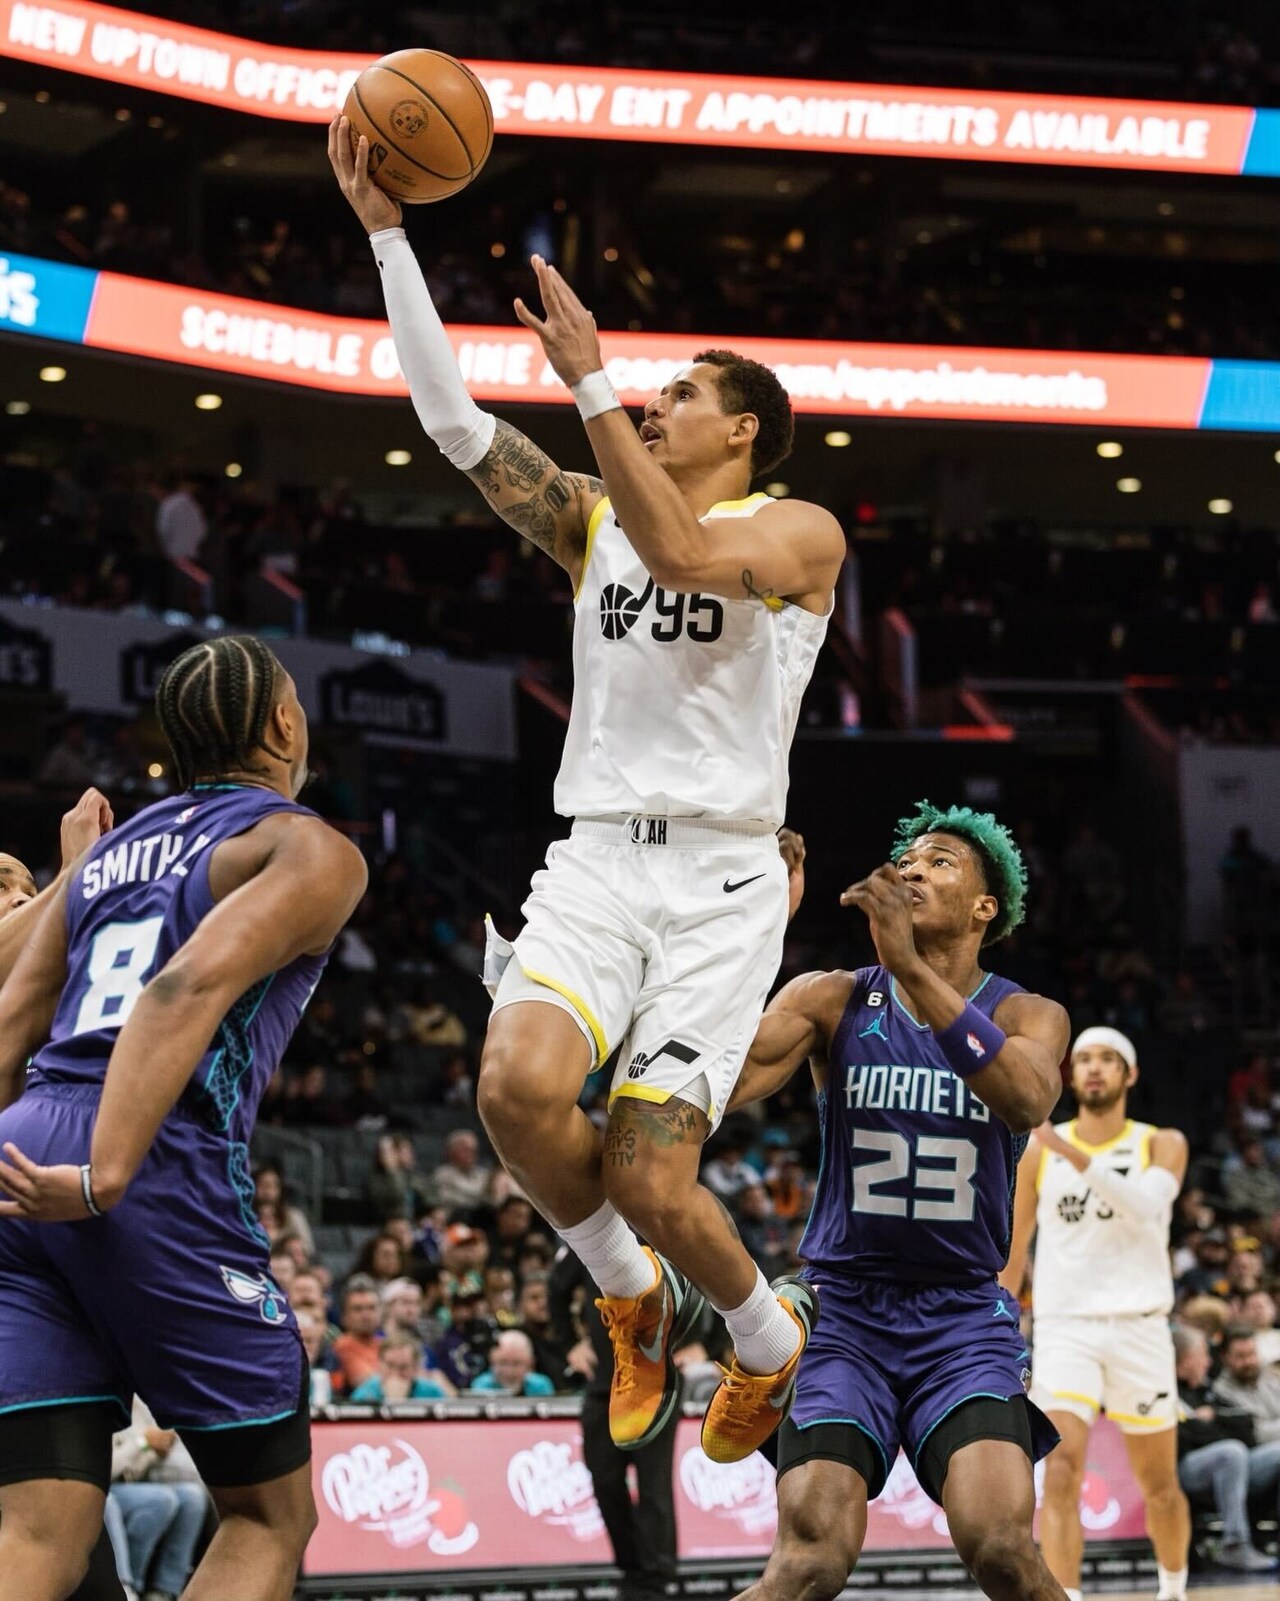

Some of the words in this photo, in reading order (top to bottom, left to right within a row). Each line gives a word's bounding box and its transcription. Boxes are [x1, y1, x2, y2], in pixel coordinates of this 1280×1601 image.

[8, 3, 86, 56] NEW
[91, 22, 231, 90] UPTOWN
[608, 84, 693, 128] ENT
[694, 92, 999, 147] APPOINTMENTS
[1004, 110, 1210, 160] AVAILABLE
[180, 305, 364, 378] SCHEDULE
[370, 337, 534, 386] OINE
[651, 583, 723, 642] 95
[631, 818, 667, 845] UAH
[72, 916, 165, 1036] 8
[867, 992, 883, 1006] 6
[843, 1064, 990, 1124] HORNETS
[851, 1128, 979, 1222] 23
